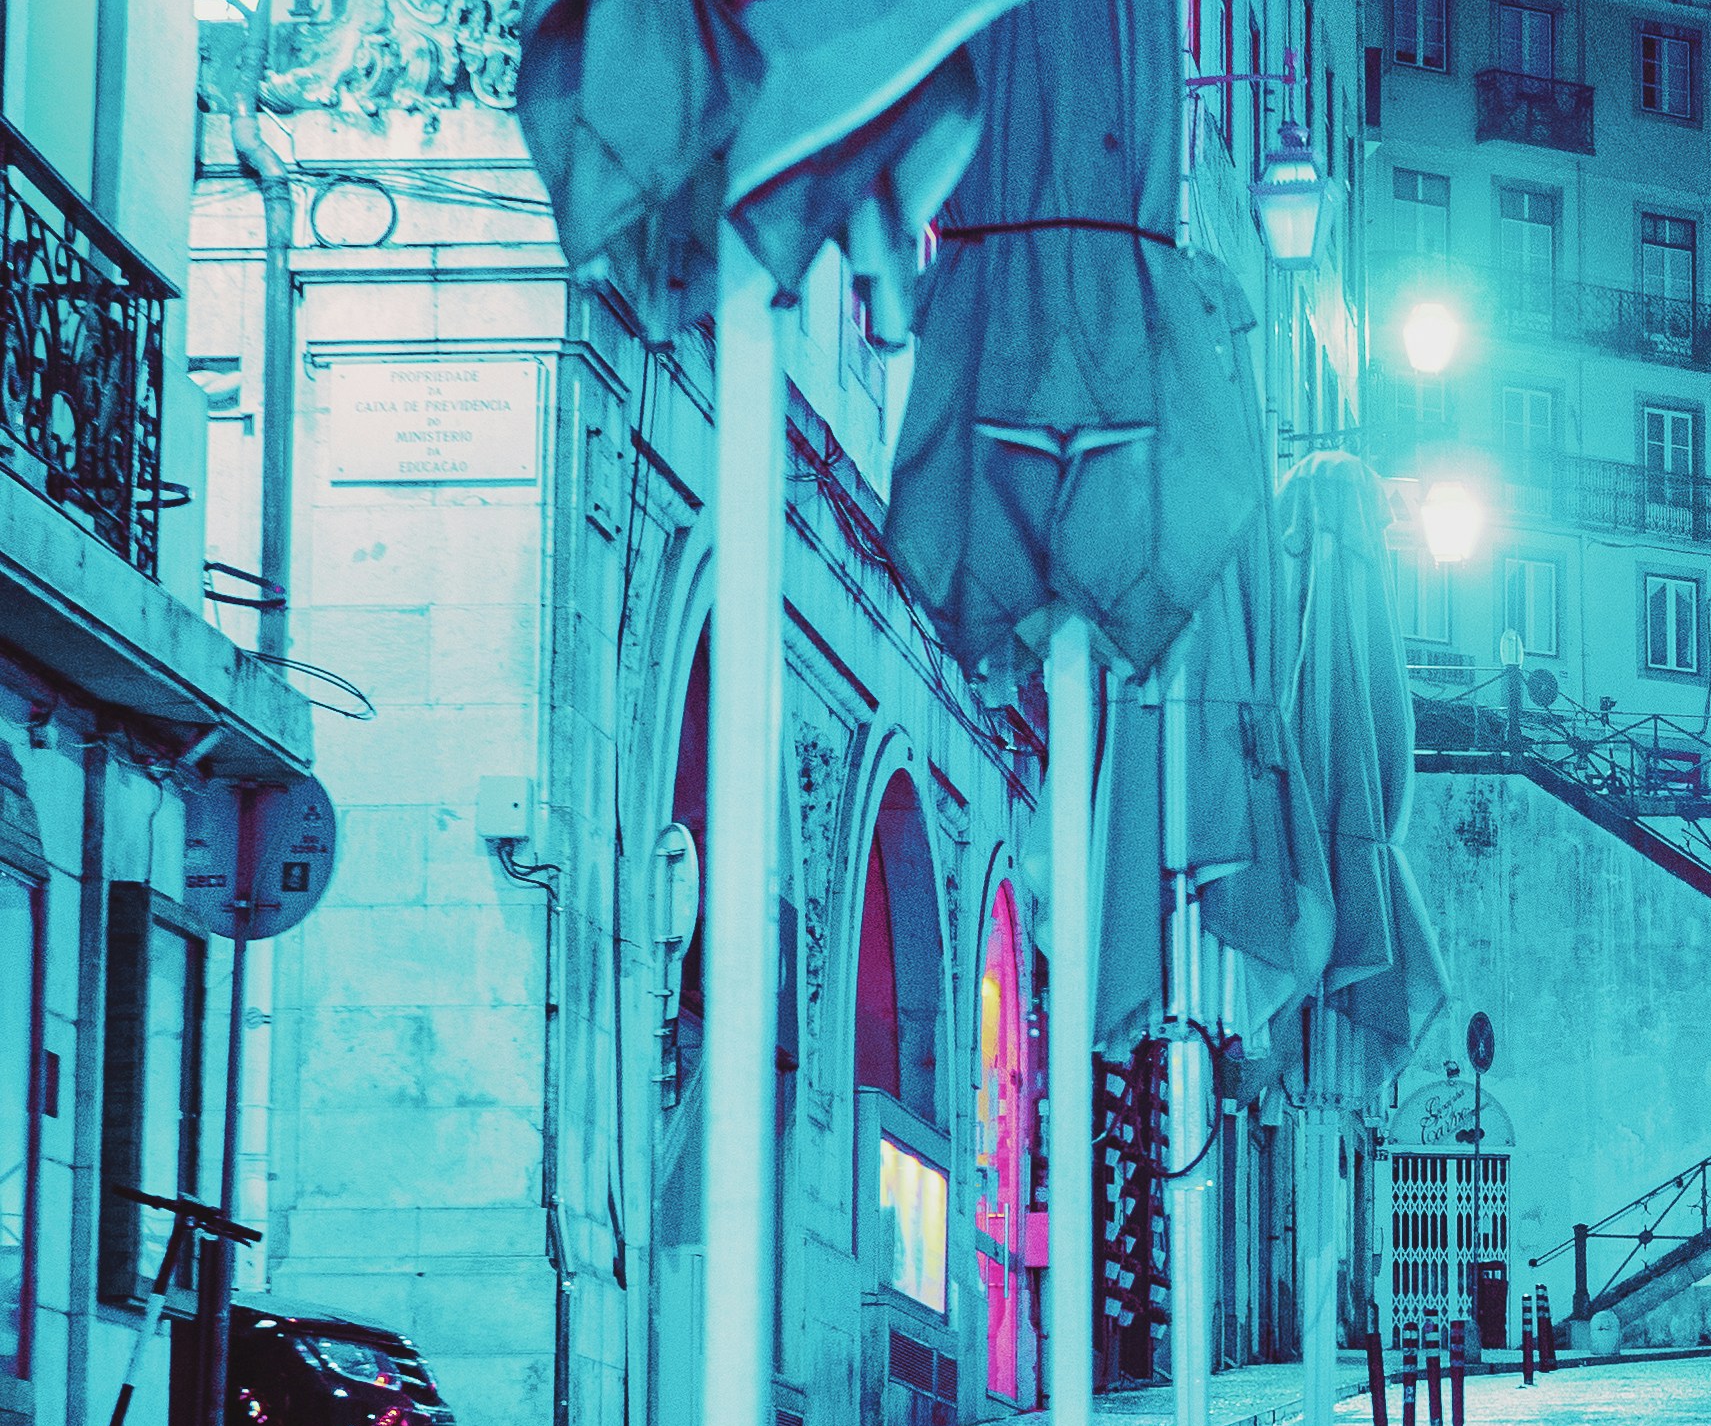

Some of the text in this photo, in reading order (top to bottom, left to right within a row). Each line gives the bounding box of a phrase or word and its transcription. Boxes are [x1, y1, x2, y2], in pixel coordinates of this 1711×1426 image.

[390, 370, 480, 383] PROPRIEDADE
[427, 386, 443, 396] DA
[355, 400, 398, 413] CAIXA
[403, 400, 420, 413] DE
[427, 418, 441, 427] DO
[427, 447, 441, 456] DA
